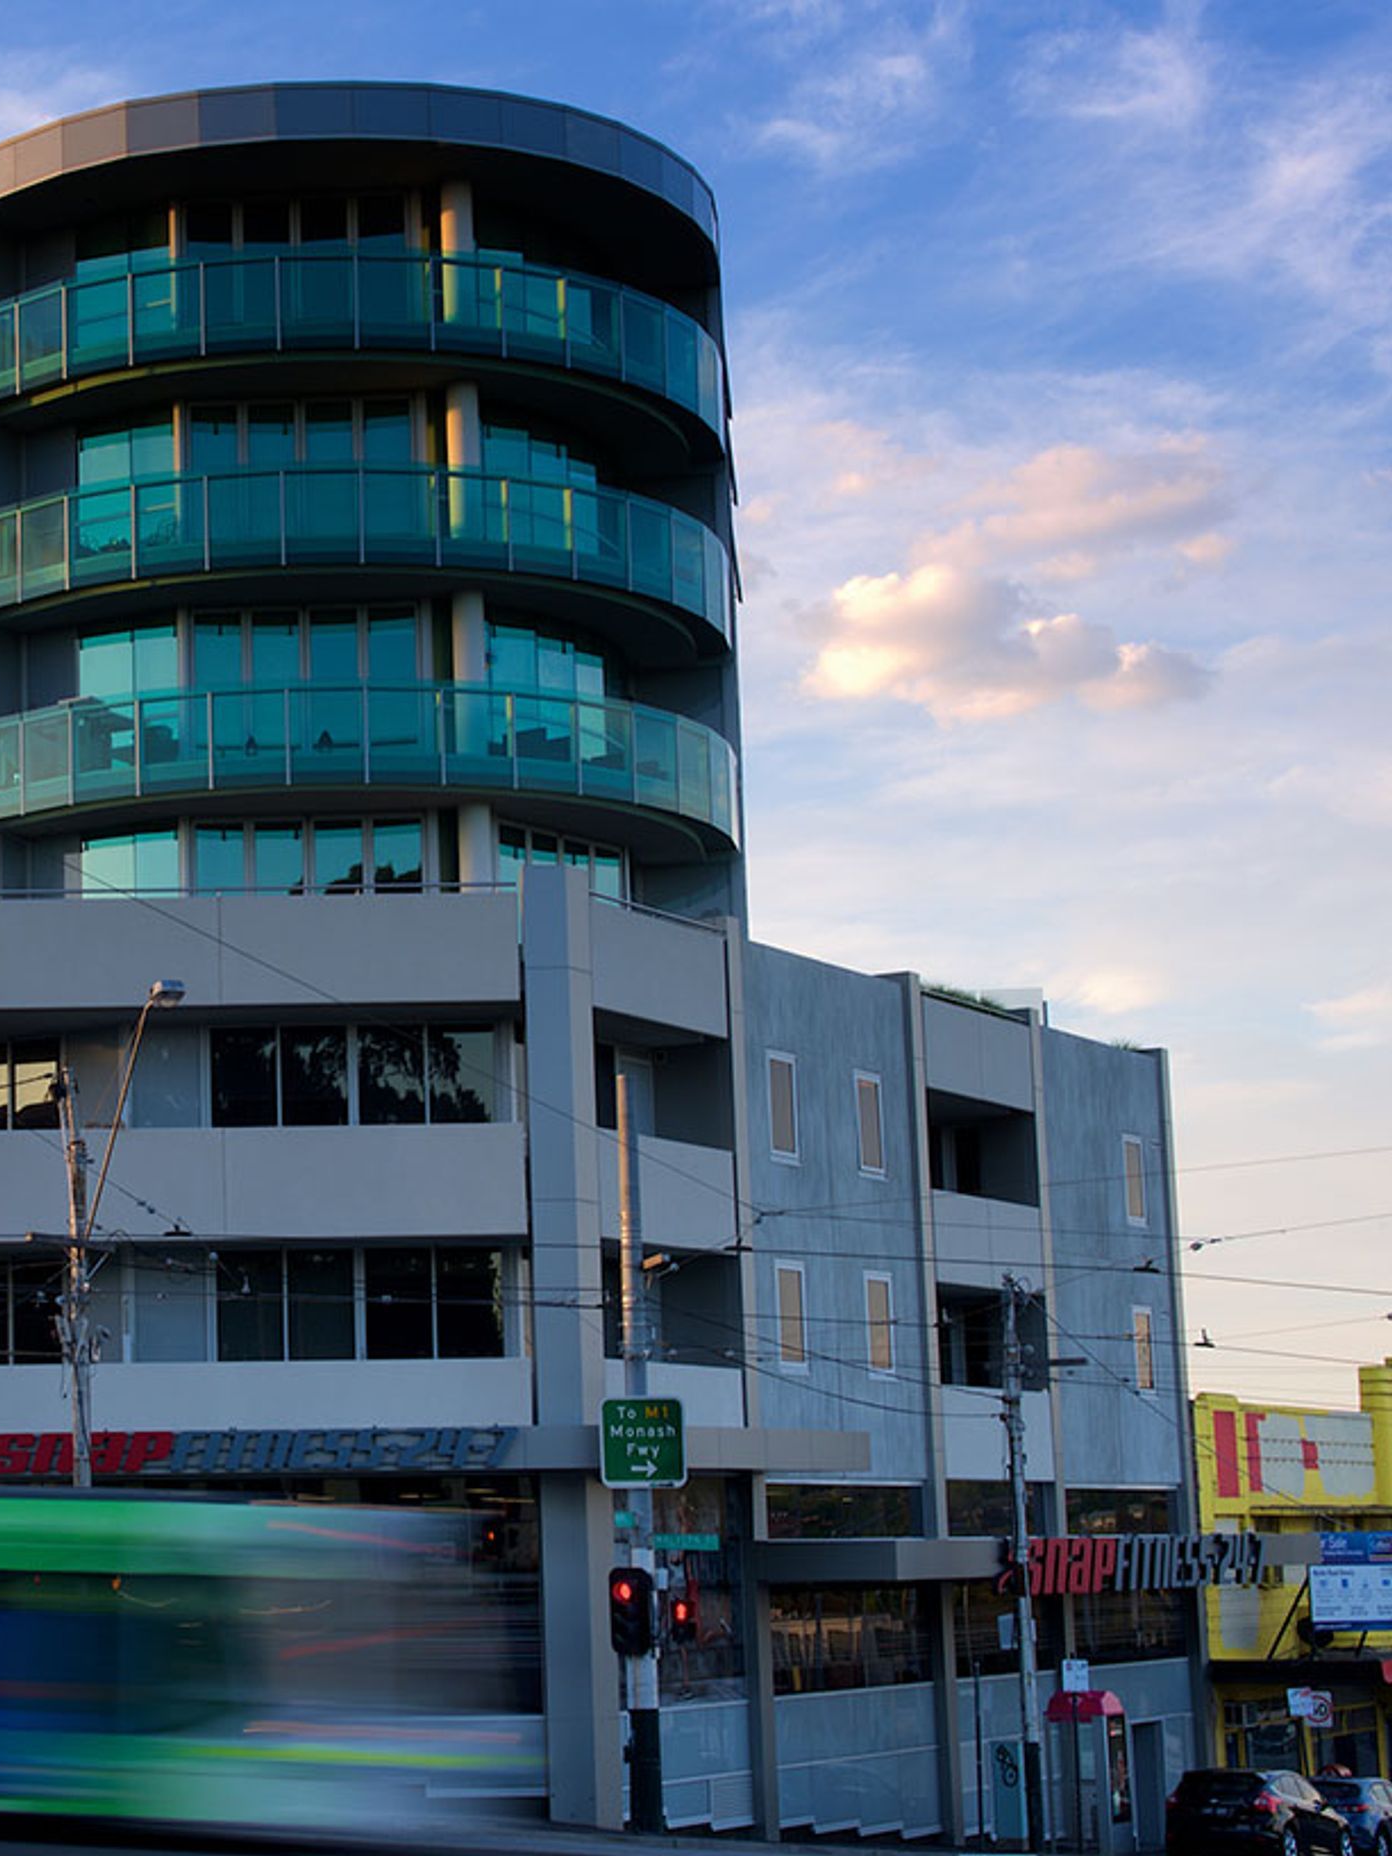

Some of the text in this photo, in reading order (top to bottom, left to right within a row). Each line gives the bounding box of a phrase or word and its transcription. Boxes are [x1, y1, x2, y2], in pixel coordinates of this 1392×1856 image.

[617, 1406, 669, 1419] To M1
[610, 1424, 676, 1438] Monash
[627, 1443, 660, 1459] Fwy
[1114, 1534, 1213, 1591] FITNESS
